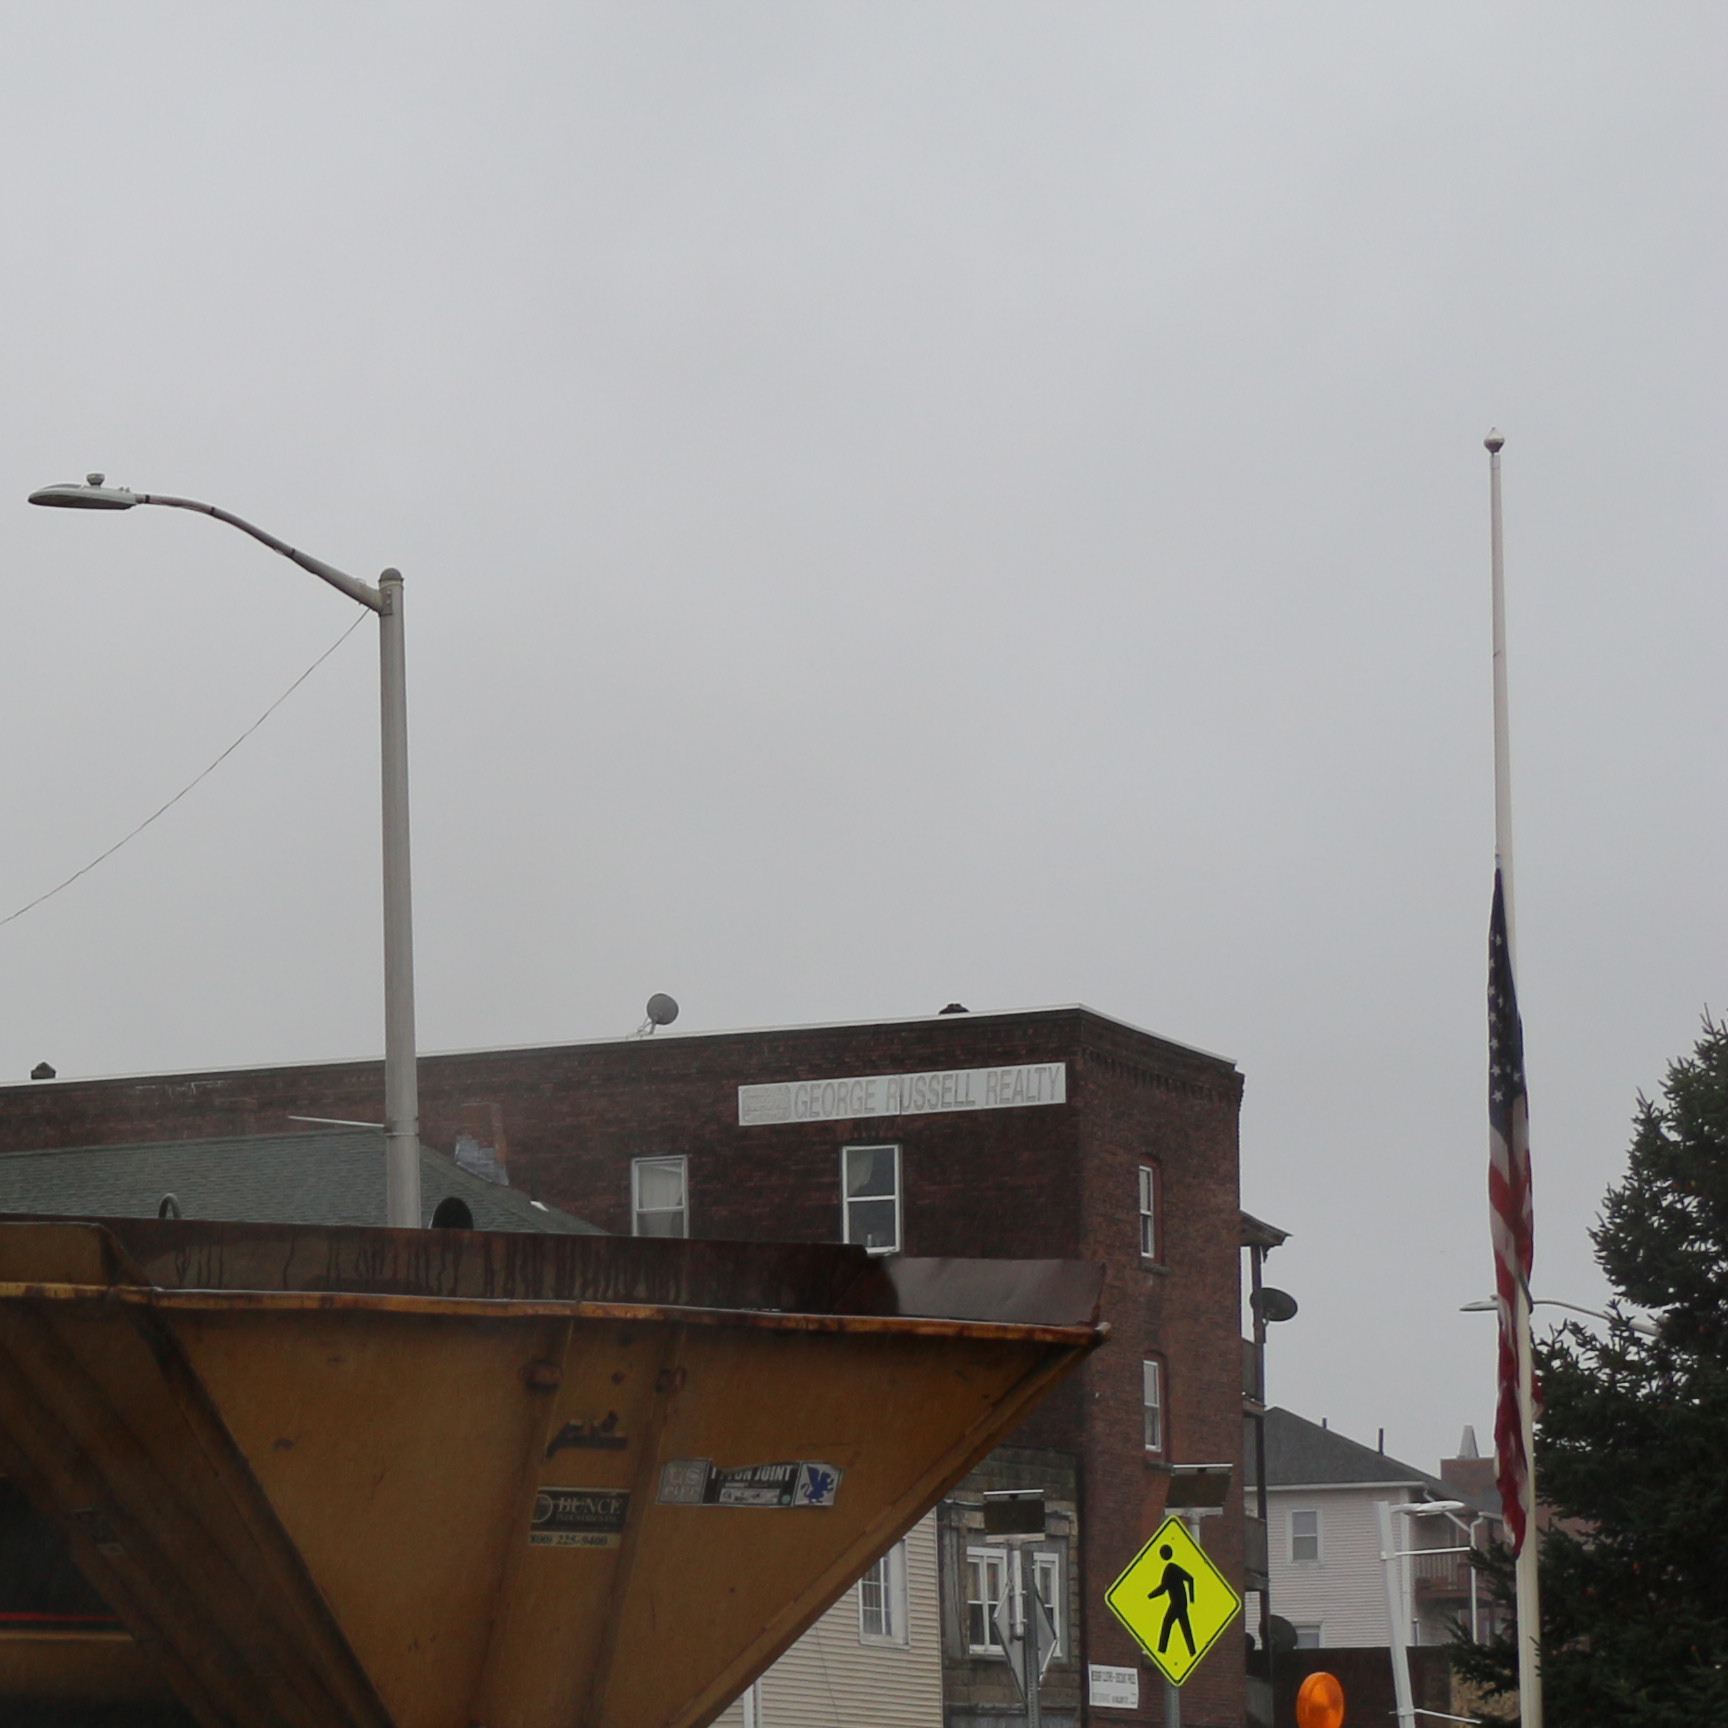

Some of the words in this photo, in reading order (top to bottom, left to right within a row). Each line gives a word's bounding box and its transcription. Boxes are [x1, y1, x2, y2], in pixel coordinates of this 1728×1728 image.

[794, 1081, 876, 1118] GEORGE
[885, 1072, 977, 1113] RUSSELL
[985, 1065, 1063, 1107] REALTY
[754, 1465, 794, 1482] JOINT
[558, 1497, 624, 1514] BUNCE
